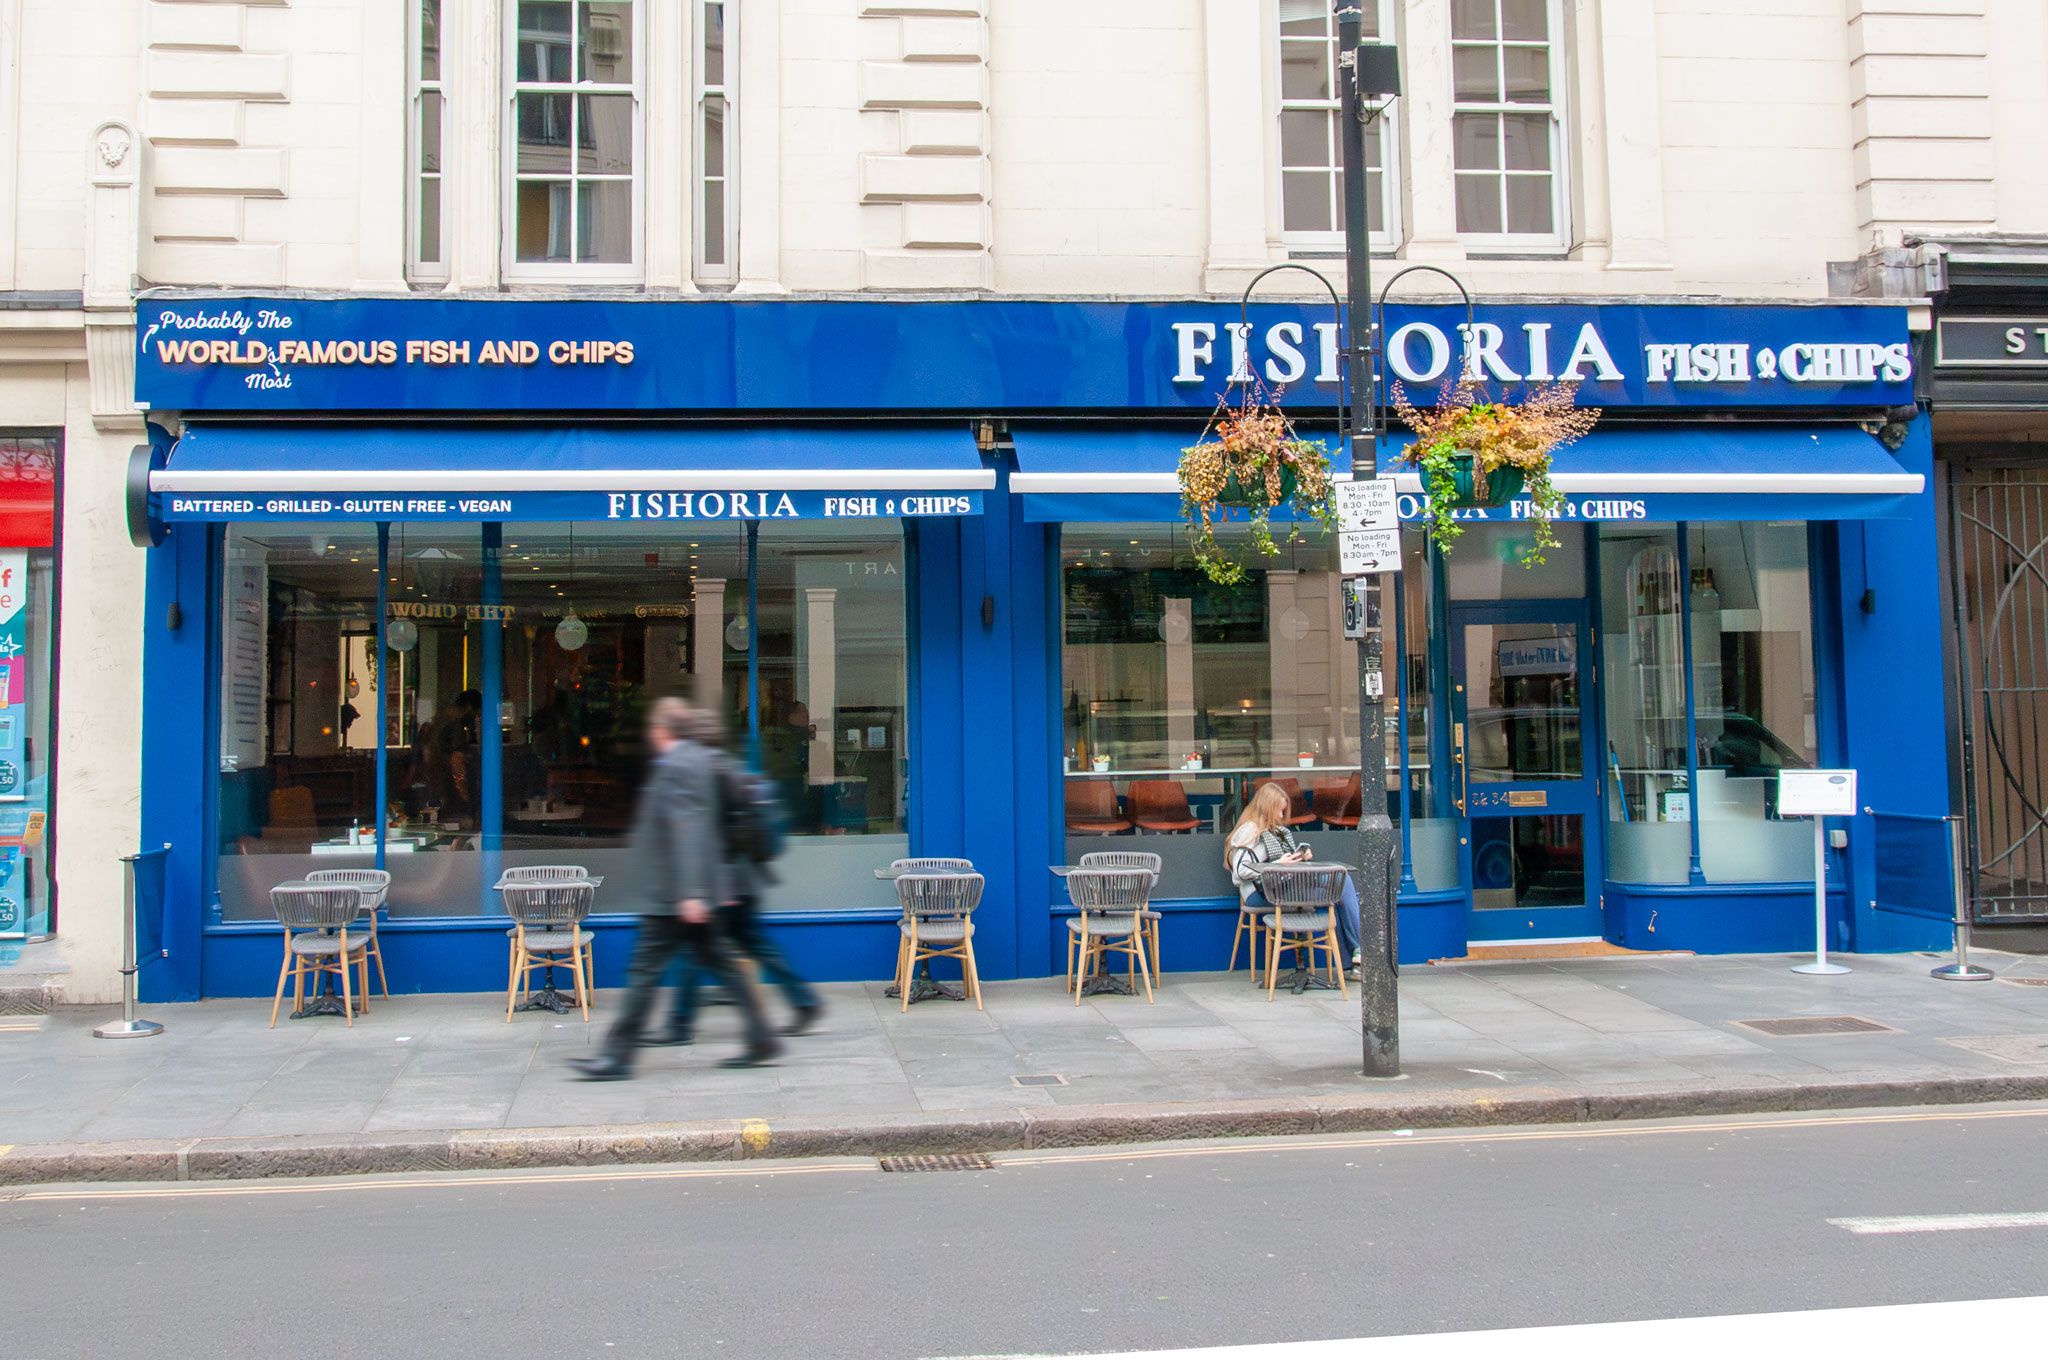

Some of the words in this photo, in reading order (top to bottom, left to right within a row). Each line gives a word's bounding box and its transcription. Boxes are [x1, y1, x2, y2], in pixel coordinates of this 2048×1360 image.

[159, 310, 253, 335] Probably
[257, 310, 293, 329] The
[279, 340, 397, 364] FAMOUS
[406, 340, 470, 364] FISH
[477, 340, 540, 364] AND
[548, 340, 635, 364] CHIPS
[1644, 343, 1751, 383] FISH
[1779, 342, 1912, 382] CHIPS
[245, 372, 292, 389] Most
[1357, 483, 1387, 491] loading
[1373, 491, 1383, 499] Fri
[173, 500, 254, 513] BATTERED
[266, 500, 332, 513] GRILLED
[343, 500, 403, 513] GLUTEN
[407, 500, 447, 513] FREE
[458, 500, 512, 513] VEGAN
[607, 493, 799, 518] FISHORIA
[823, 497, 877, 517] FISH
[900, 496, 971, 516] CHIPS
[1581, 500, 1647, 519] CHIPS
[1361, 533, 1391, 541] loading
[1380, 549, 1398, 557] 7pm
